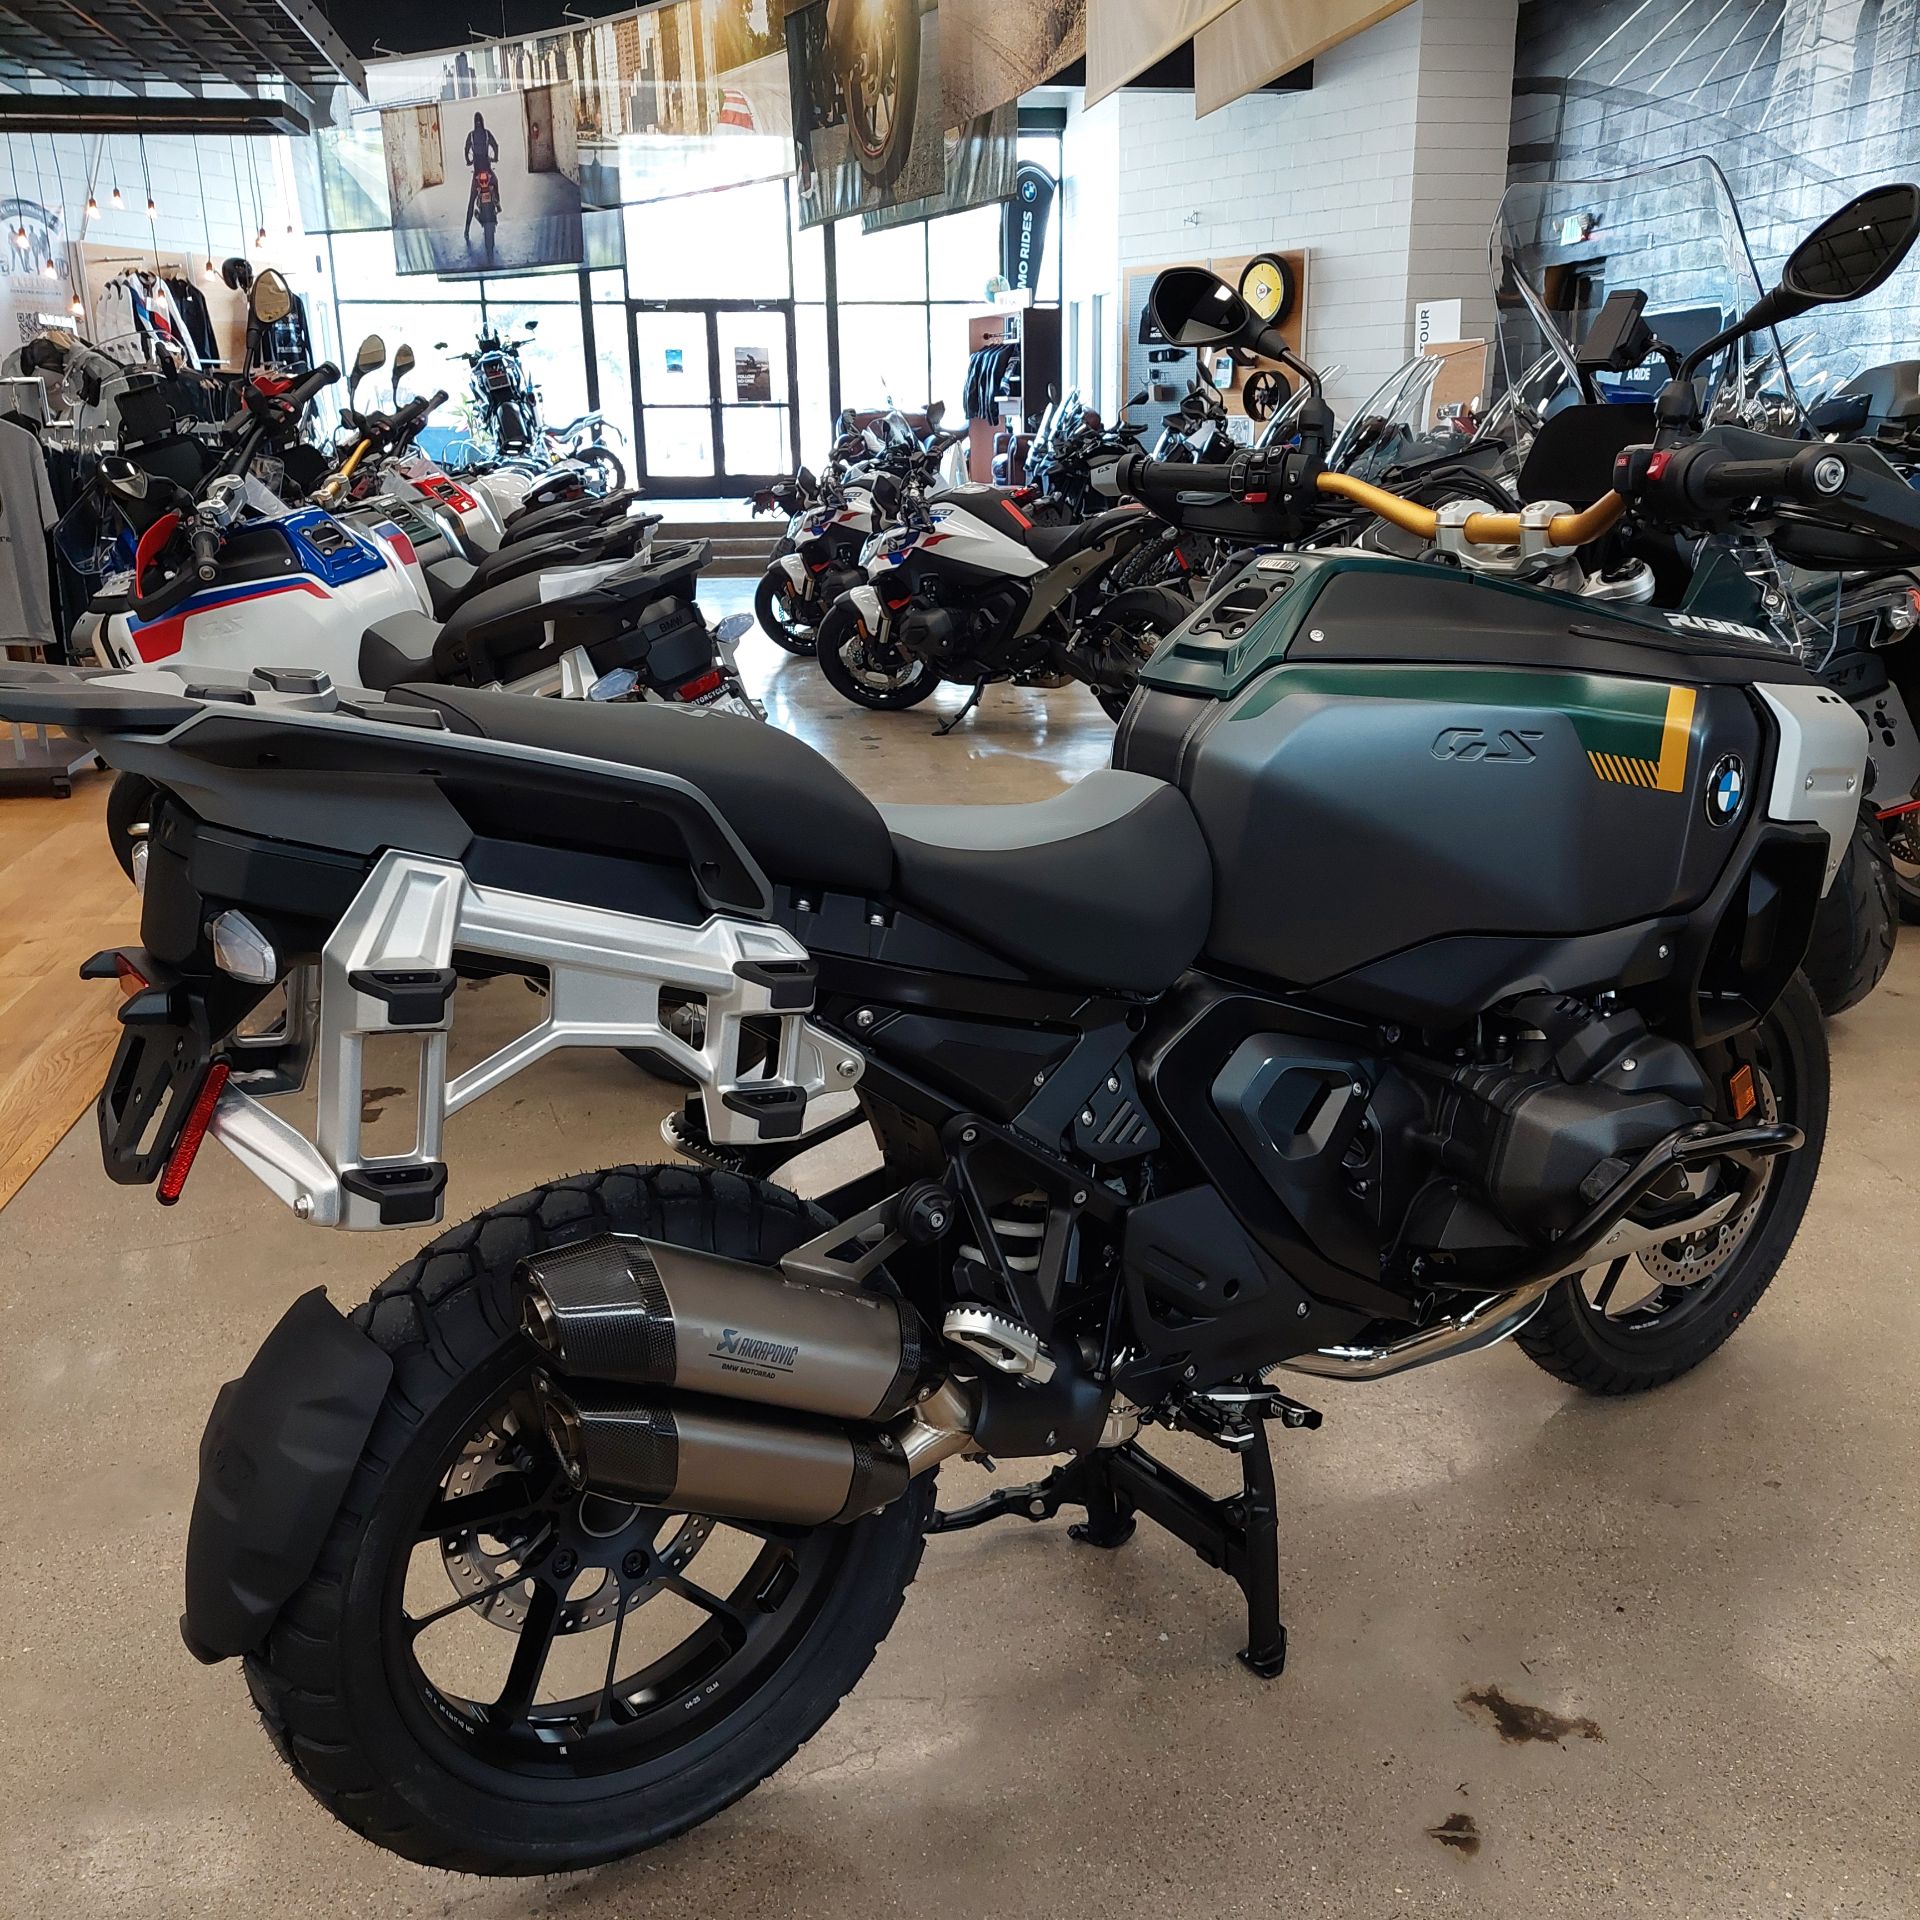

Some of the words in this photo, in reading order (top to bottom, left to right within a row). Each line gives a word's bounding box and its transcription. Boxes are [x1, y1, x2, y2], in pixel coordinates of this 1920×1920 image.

[1020, 210, 1033, 259] RIDES
[659, 615, 684, 633] BMW
[1663, 612, 1773, 644] R1300
[1431, 726, 1545, 764] GS
[721, 1362, 740, 1373] BMW
[739, 1365, 776, 1380] MOTORRAD
[705, 1681, 720, 1694] GLM
